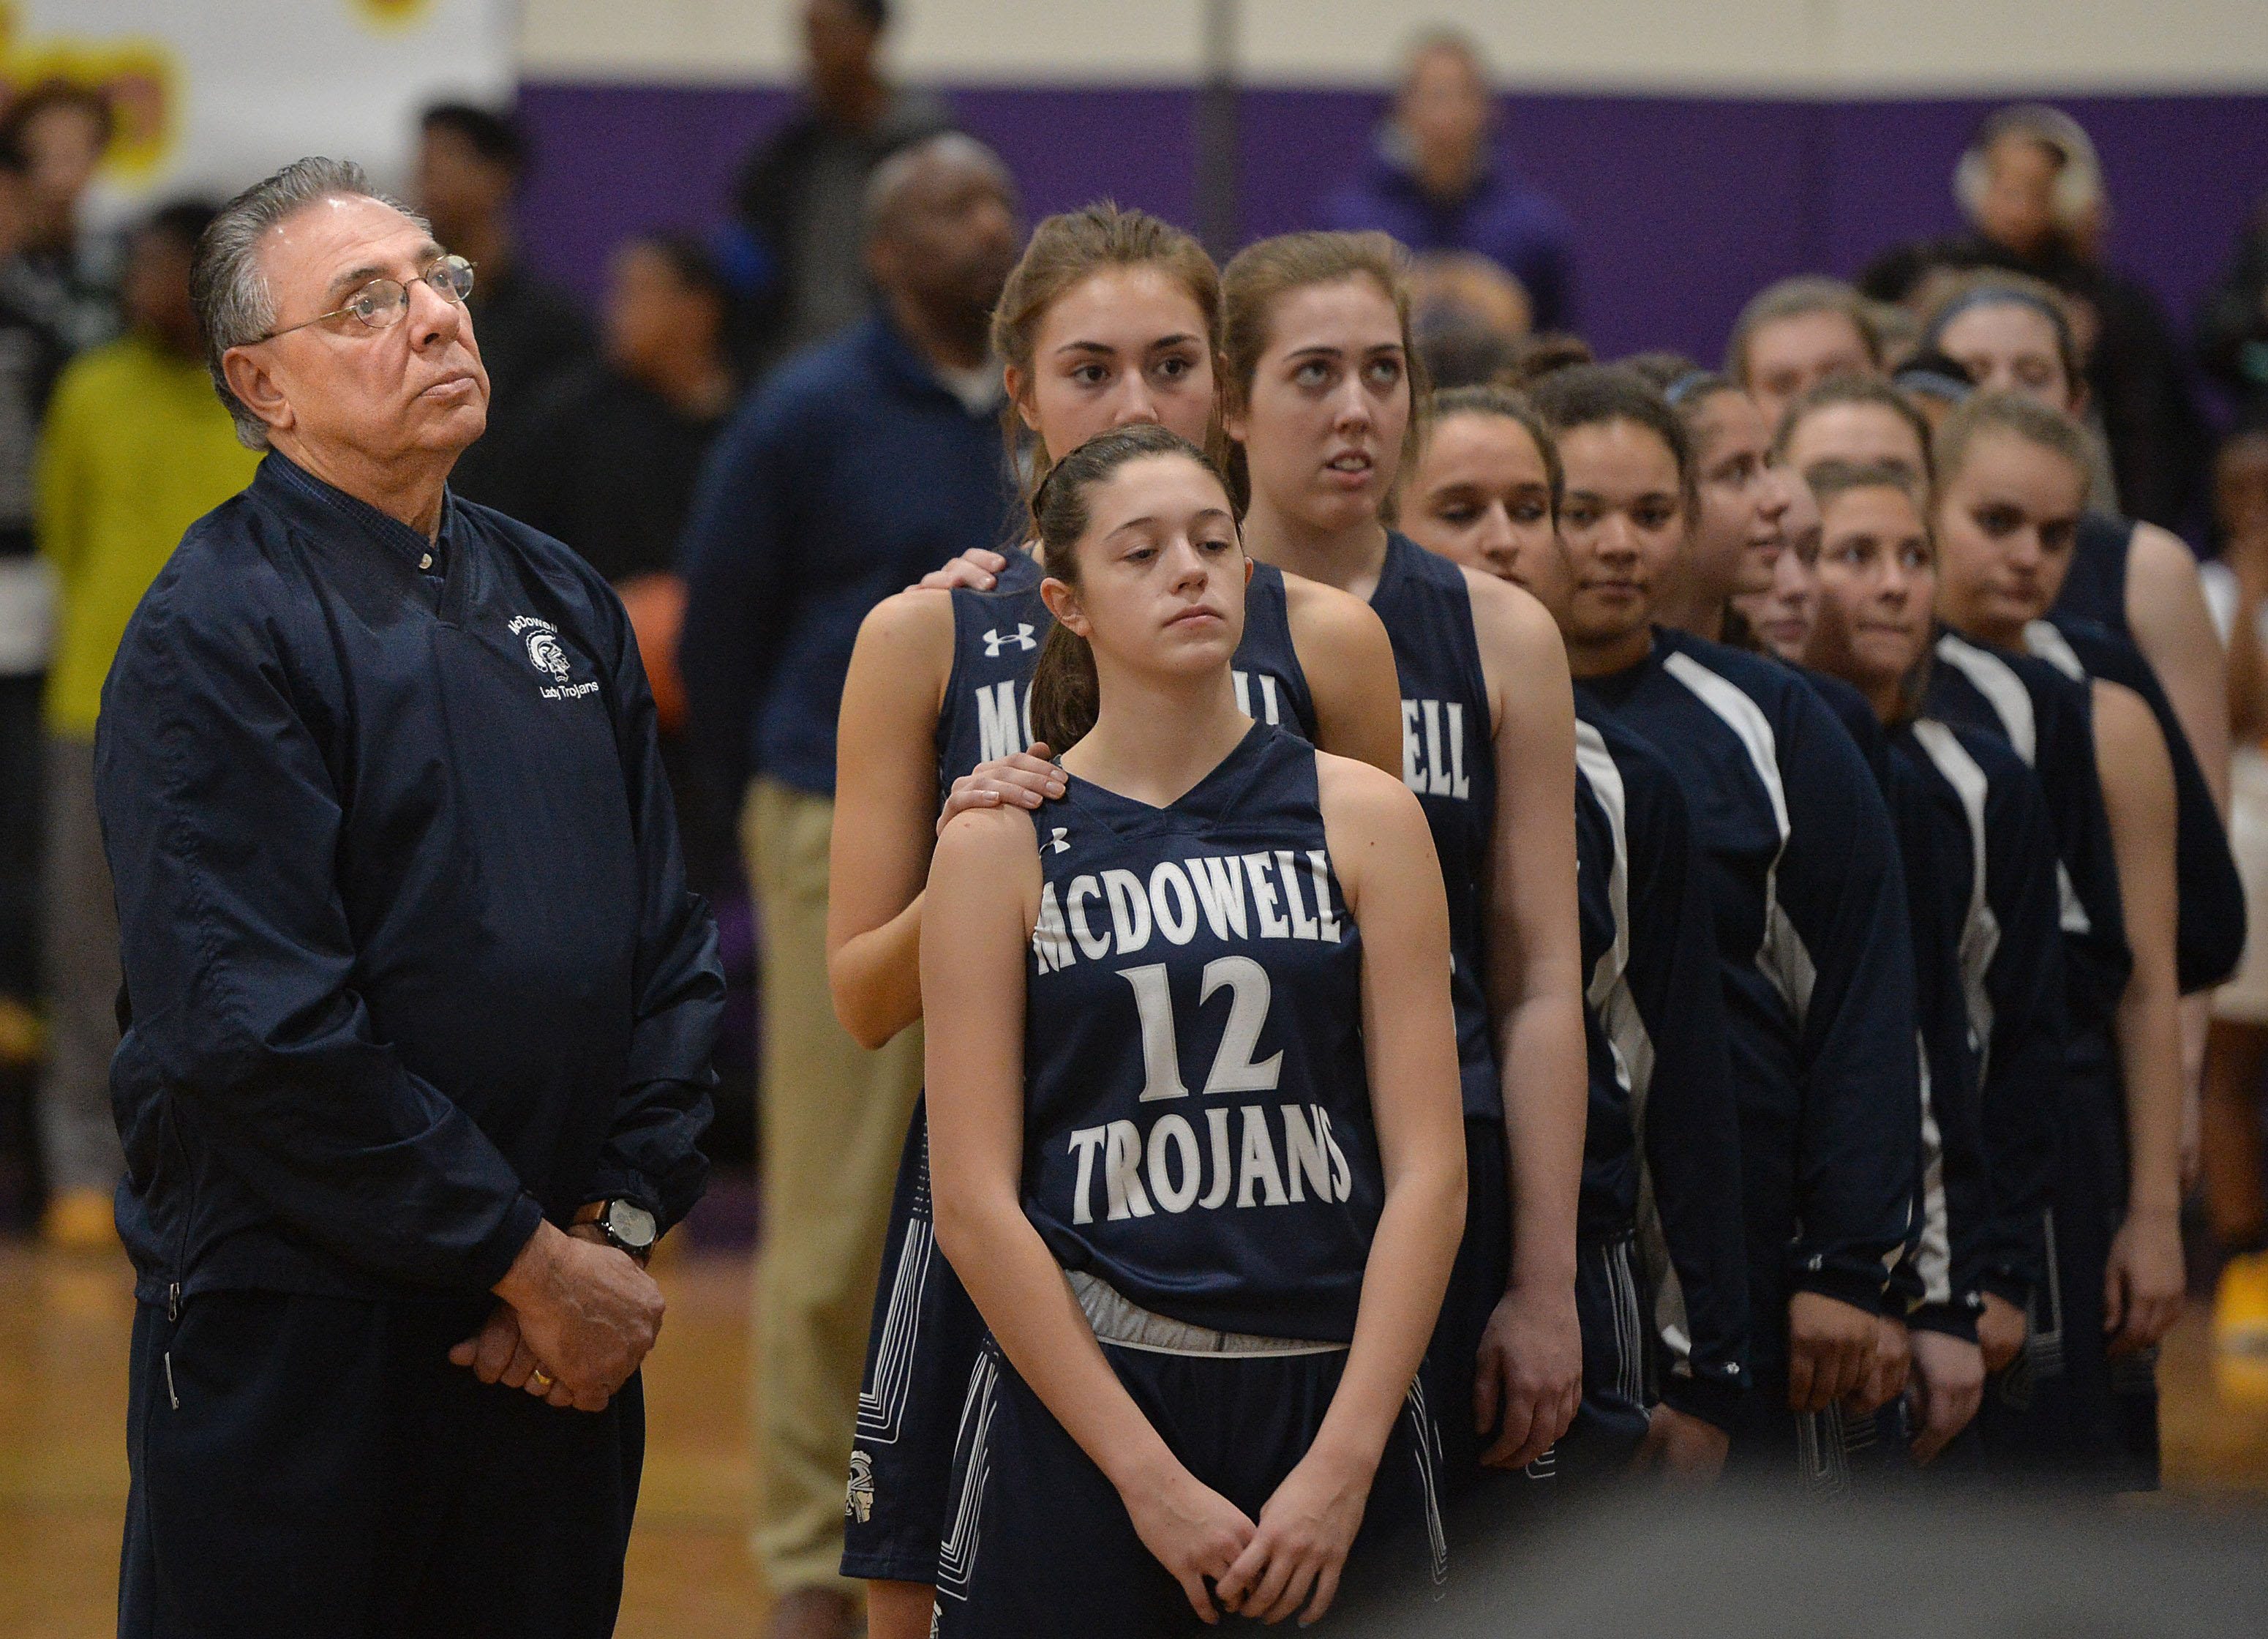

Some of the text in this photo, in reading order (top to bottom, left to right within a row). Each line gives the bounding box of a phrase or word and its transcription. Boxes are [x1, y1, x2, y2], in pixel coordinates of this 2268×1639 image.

[508, 615, 557, 635] McDowell
[540, 681, 599, 700] Lady Trojans
[1032, 849, 1341, 975] MCDOWELL
[1115, 955, 1284, 1103] 12
[1067, 1103, 1352, 1225] TROJANS
